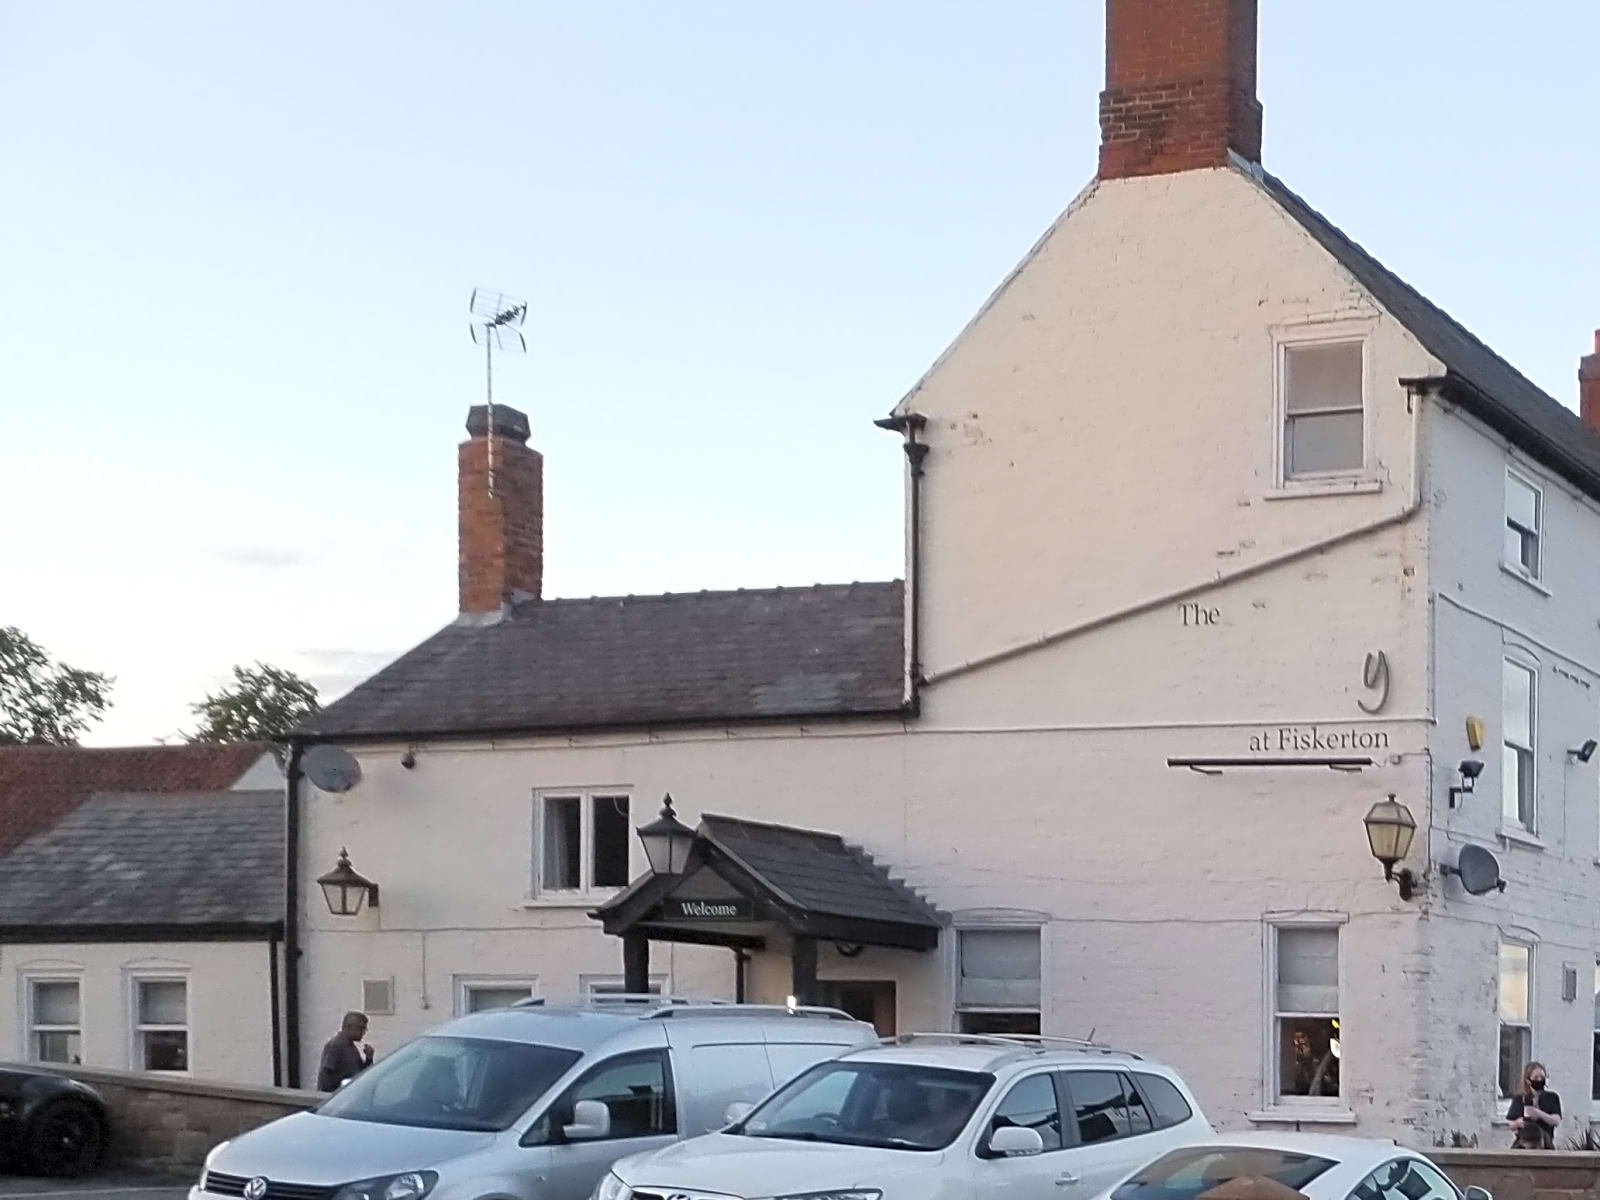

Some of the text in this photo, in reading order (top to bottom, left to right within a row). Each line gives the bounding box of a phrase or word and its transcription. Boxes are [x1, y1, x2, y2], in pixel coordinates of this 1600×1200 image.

[1177, 603, 1220, 625] The
[1249, 727, 1389, 751] at Fiskerton
[681, 902, 737, 916] Welcome
